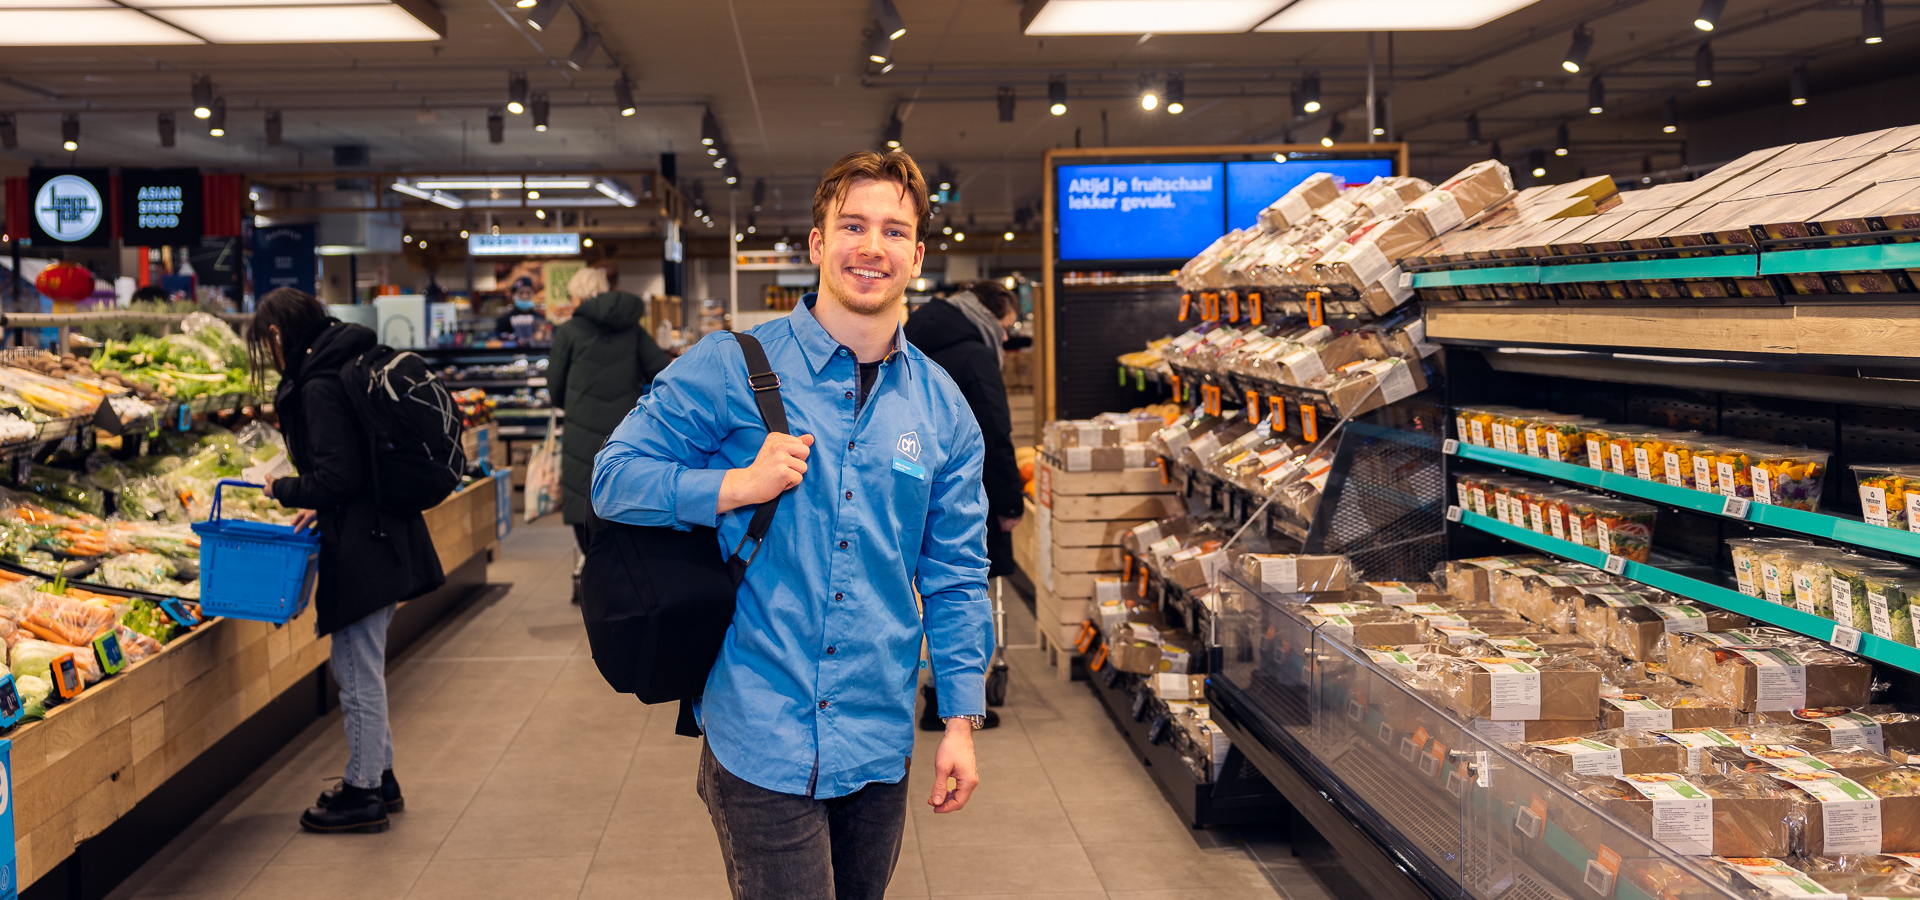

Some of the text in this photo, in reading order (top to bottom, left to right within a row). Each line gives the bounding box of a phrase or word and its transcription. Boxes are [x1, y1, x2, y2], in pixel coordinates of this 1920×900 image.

[138, 186, 182, 200] ASIAN
[1068, 176, 1212, 196] Altijd je fruitschaal
[138, 200, 183, 214] STREET
[1068, 193, 1176, 212] lekker gevuld.
[138, 214, 179, 228] FOOD
[532, 235, 570, 246] DAILY
[1601, 849, 1618, 866] BONUS
